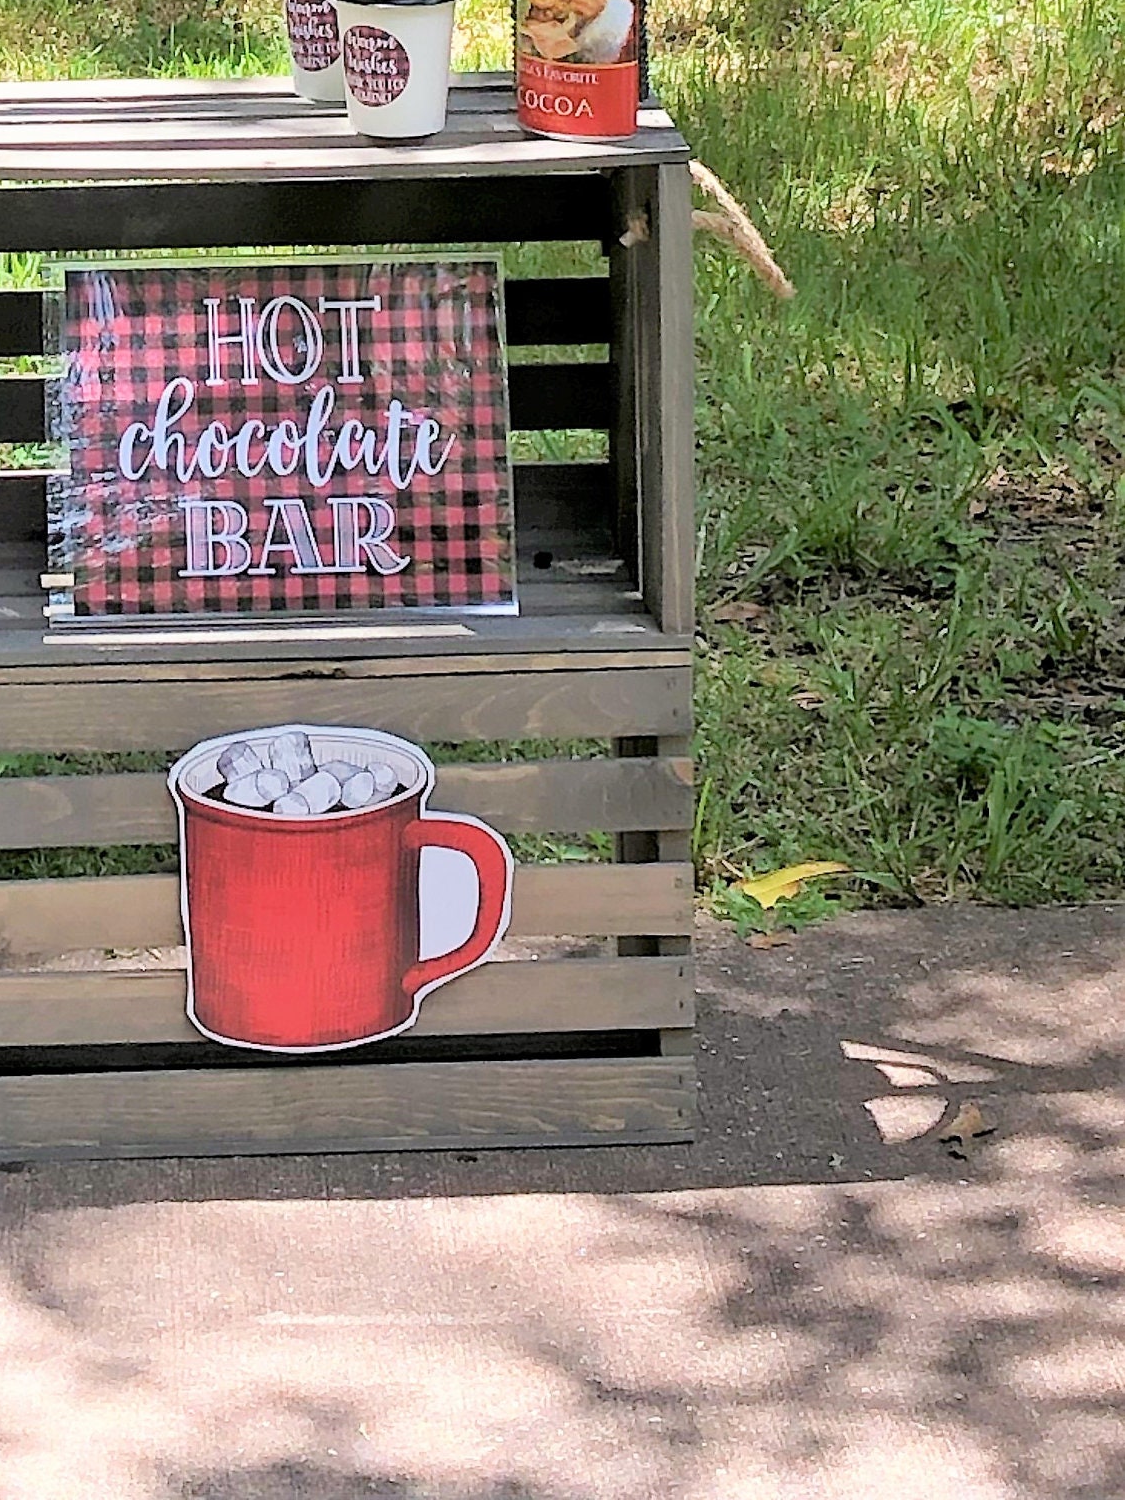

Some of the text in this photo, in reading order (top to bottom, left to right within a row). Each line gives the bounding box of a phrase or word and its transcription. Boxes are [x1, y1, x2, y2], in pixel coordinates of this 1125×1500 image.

[517, 86, 594, 119] COCOA
[203, 294, 381, 386] HOT
[118, 378, 457, 490] chocolate
[178, 499, 411, 577] BAR
